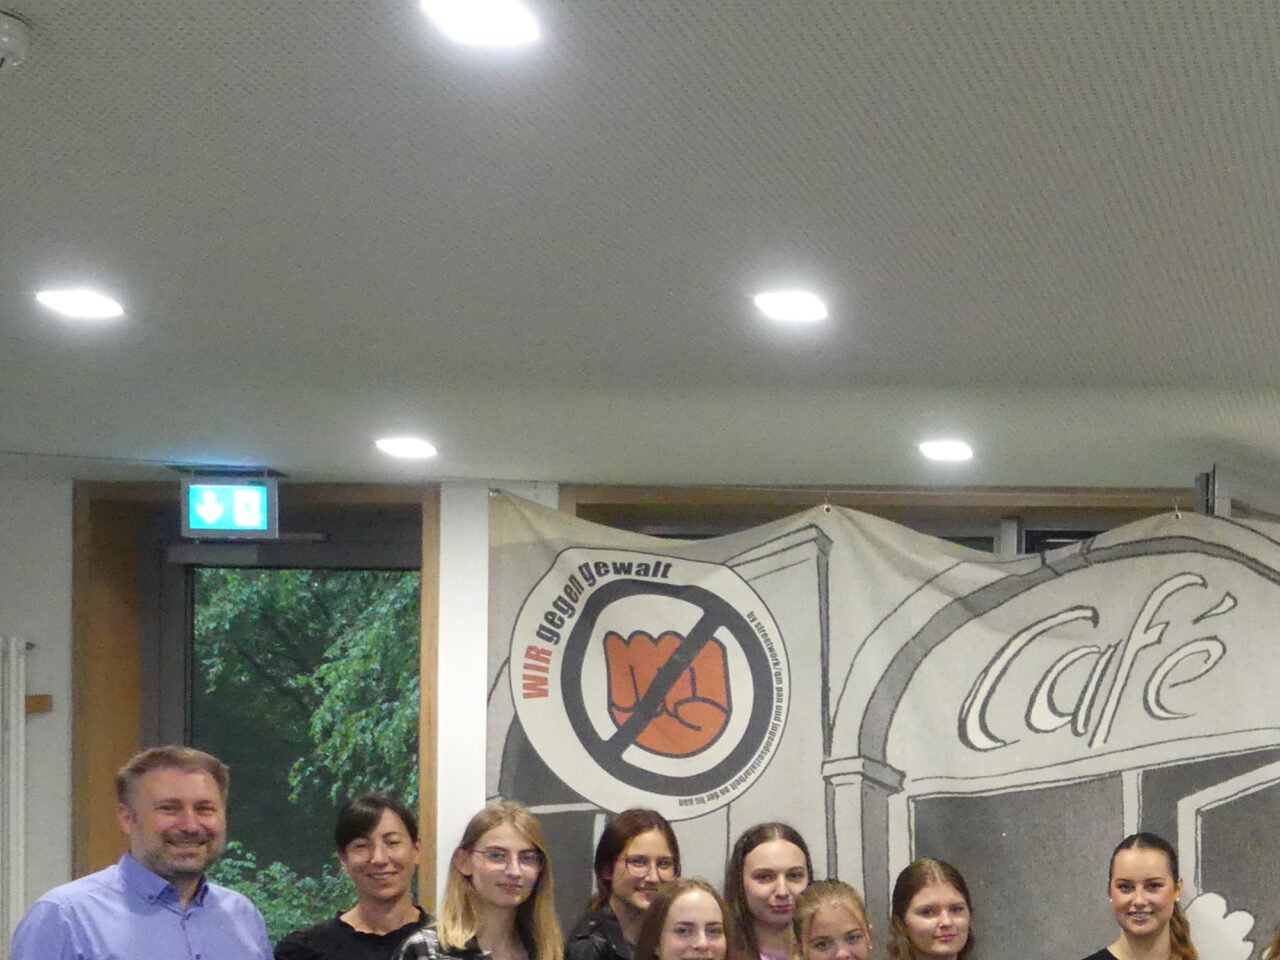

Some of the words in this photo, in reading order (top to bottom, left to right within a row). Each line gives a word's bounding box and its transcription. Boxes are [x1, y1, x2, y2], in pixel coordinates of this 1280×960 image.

[578, 561, 672, 587] gewalt
[536, 574, 584, 645] gegen
[746, 610, 758, 623] by
[522, 645, 552, 699] WIR
[957, 571, 1237, 752] Café
[773, 704, 783, 722] und
[706, 791, 720, 802] der
